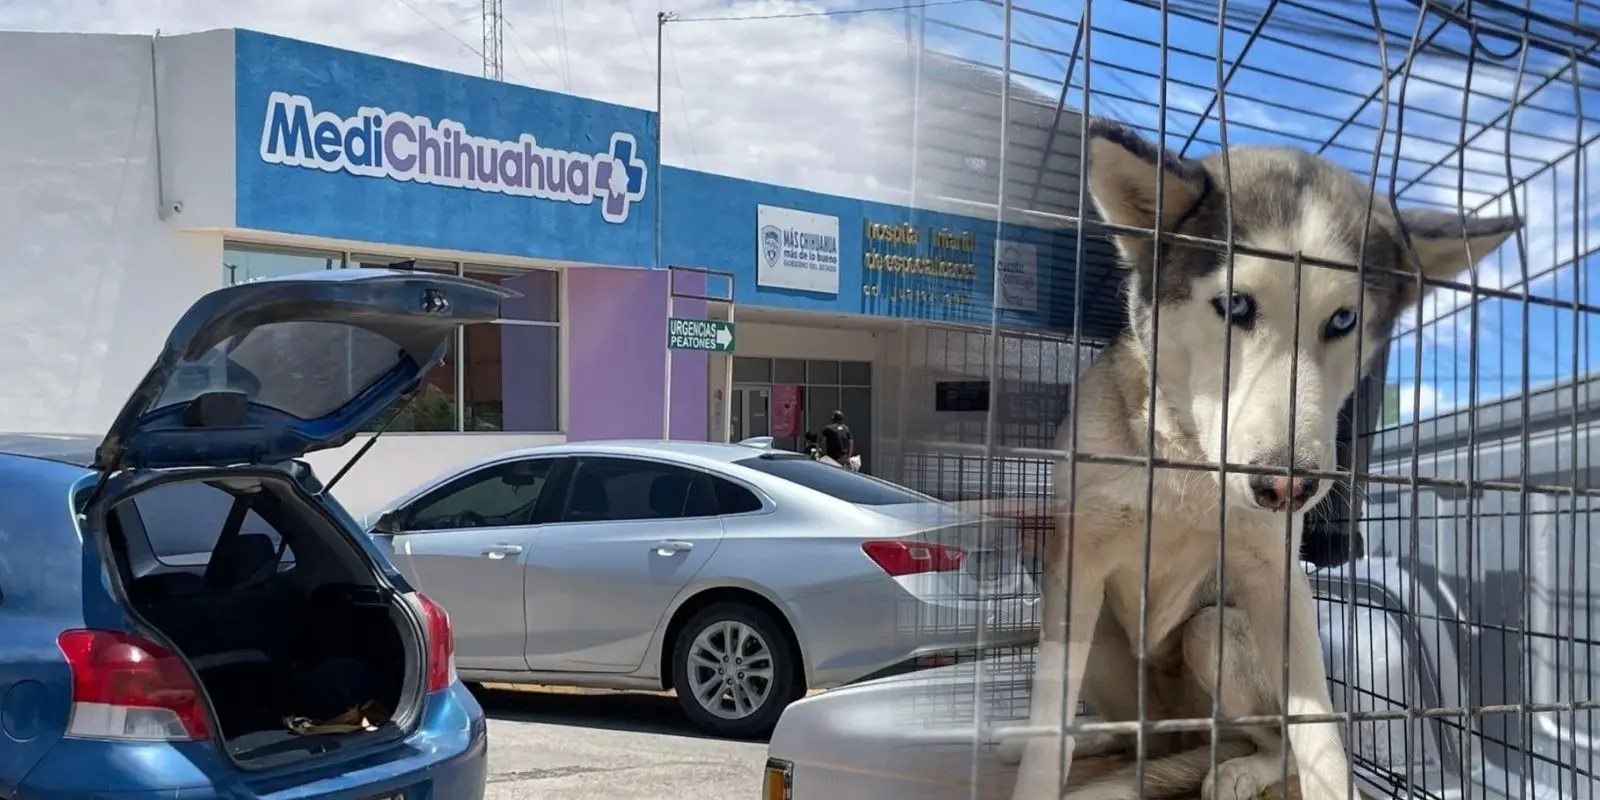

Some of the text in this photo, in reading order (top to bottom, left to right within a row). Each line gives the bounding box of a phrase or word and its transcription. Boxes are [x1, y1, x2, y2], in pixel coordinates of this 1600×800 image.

[266, 101, 589, 196] MediChihuahua
[783, 228, 837, 253] MÁS CHIHUAHUA
[866, 219, 918, 246] hospita
[783, 249, 837, 265] más de lo bueno
[670, 320, 716, 338] URGENCIAS
[671, 336, 716, 349] PEATONES
